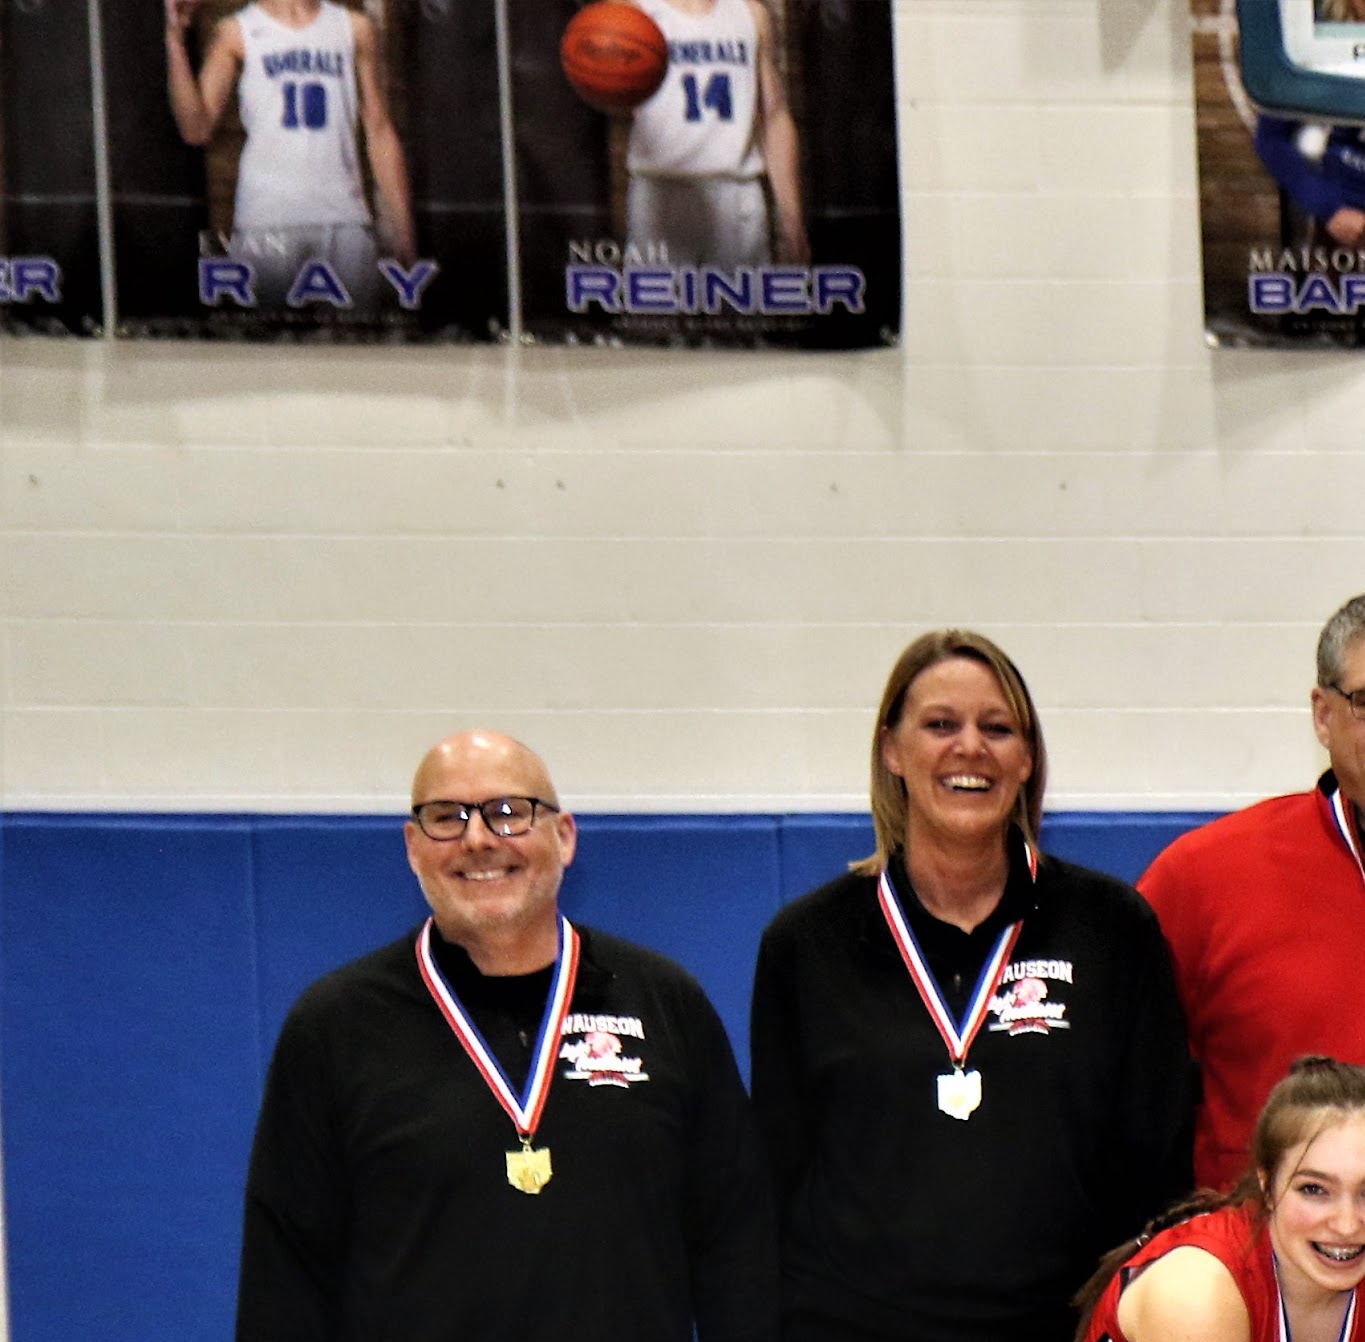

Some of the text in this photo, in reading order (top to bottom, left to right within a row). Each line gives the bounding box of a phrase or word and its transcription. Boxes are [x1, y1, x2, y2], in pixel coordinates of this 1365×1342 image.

[282, 82, 327, 130] 10
[682, 73, 732, 122] 14
[568, 239, 669, 265] NOAH
[565, 264, 867, 315] REINER
[999, 959, 1074, 985] AUSEON
